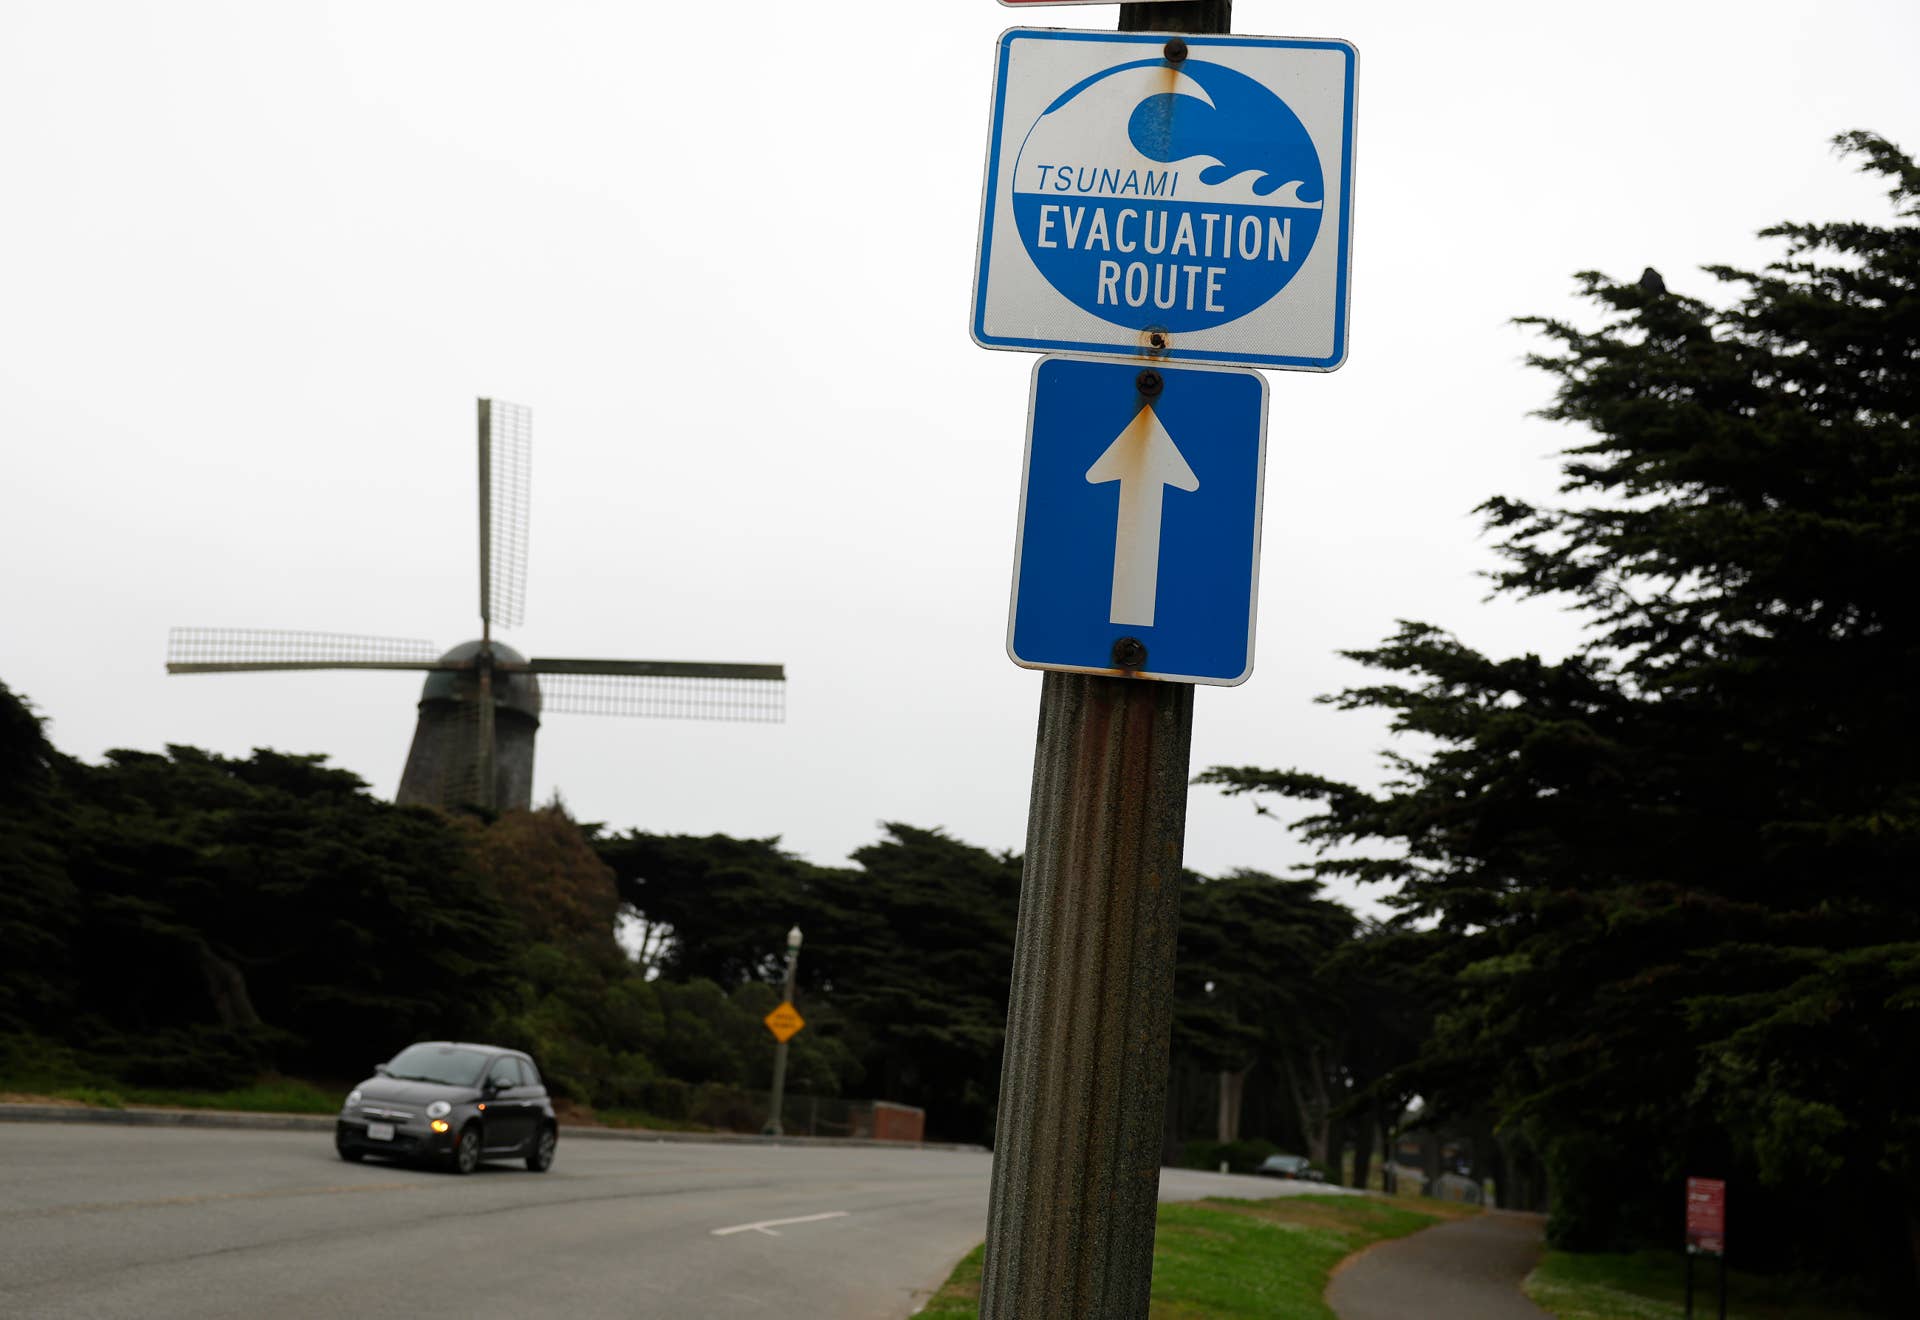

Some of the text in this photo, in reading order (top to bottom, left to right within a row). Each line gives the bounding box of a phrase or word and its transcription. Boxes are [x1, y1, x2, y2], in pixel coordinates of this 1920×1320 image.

[1037, 165, 1179, 197] TSUNAMI
[1037, 204, 1292, 262] EVACUATION
[1096, 260, 1227, 313] ROUTE
